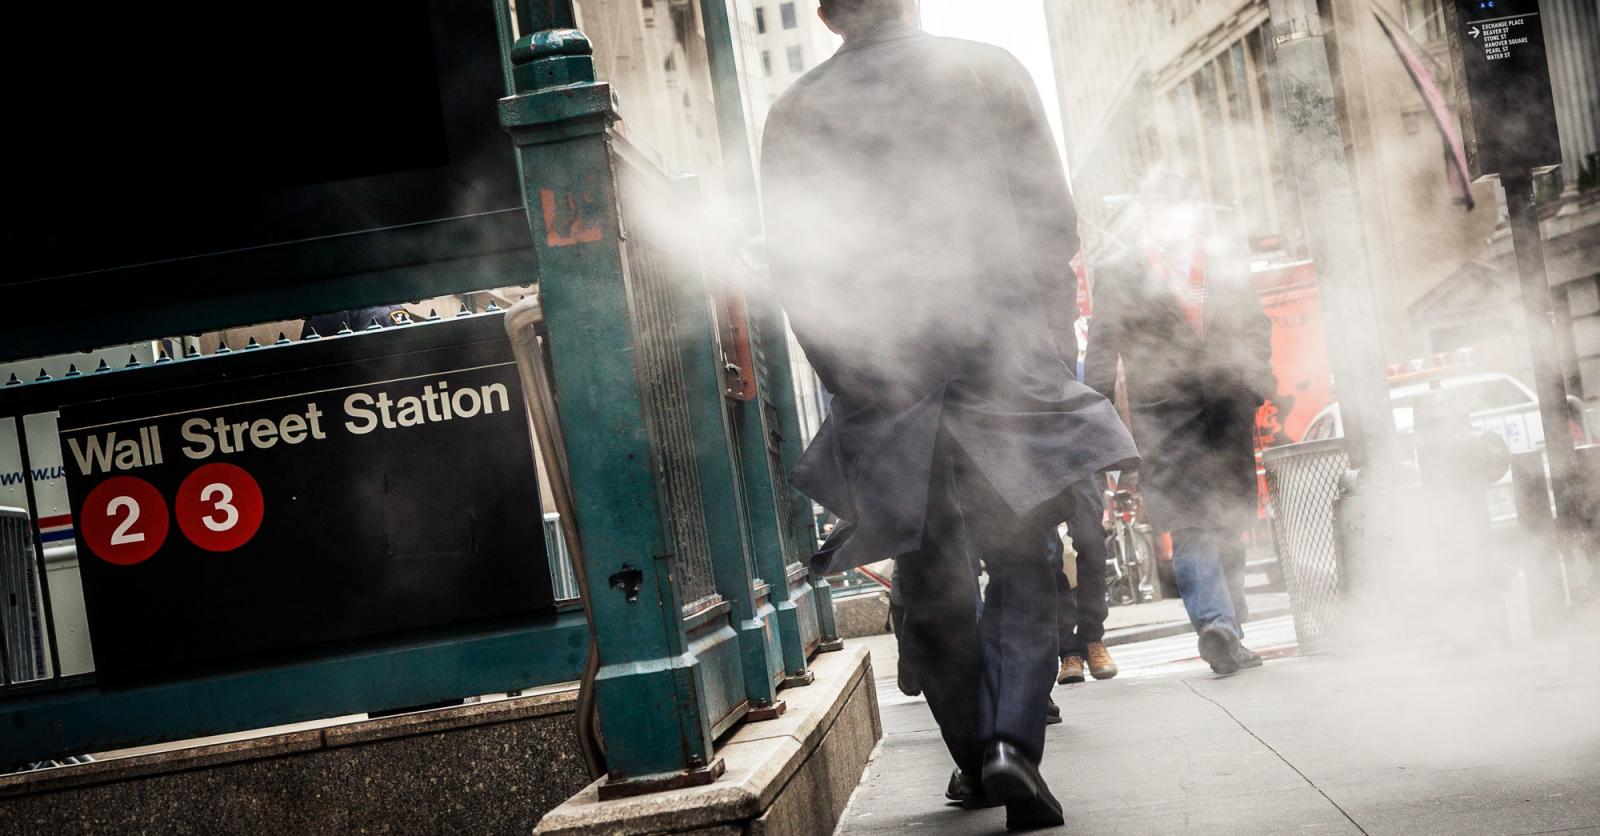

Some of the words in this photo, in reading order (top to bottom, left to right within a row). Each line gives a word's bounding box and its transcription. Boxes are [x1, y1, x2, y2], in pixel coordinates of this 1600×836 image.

[1482, 21, 1508, 30] EXCHANGE
[1483, 28, 1502, 36] BEAVER
[1484, 40, 1508, 48] HANOVER
[1508, 37, 1528, 45] SQUARE
[67, 425, 164, 476] Wall
[181, 403, 326, 461] Street
[343, 380, 510, 436] Station
[105, 495, 145, 546] 2
[200, 482, 239, 532] 3
